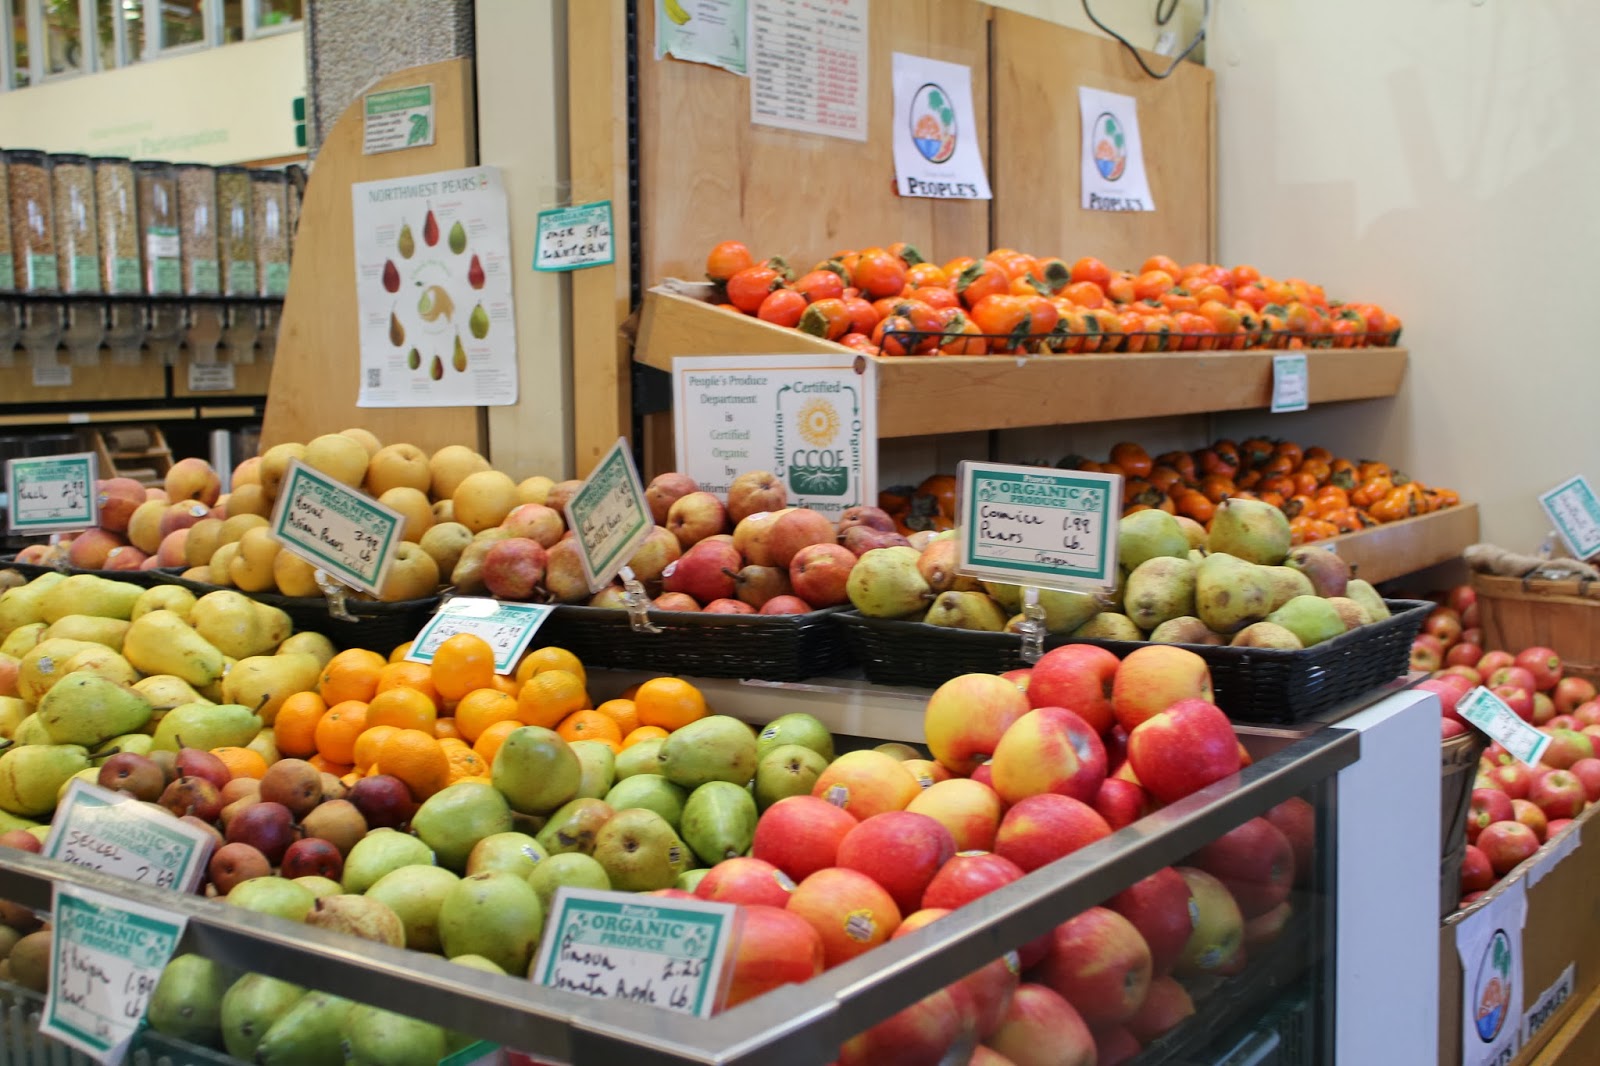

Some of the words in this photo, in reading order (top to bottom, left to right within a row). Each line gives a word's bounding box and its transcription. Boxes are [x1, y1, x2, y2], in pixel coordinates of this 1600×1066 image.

[368, 182, 438, 204] NORTHWEST
[441, 176, 477, 194] PEARS
[543, 242, 607, 260] LANTERN
[688, 375, 727, 388] People's
[728, 374, 769, 387] Produce
[792, 381, 842, 395] Certified
[700, 393, 758, 407] Department
[724, 411, 734, 423] is
[709, 429, 750, 441] Certified
[774, 412, 785, 478] California
[849, 419, 862, 474] Organic
[711, 448, 750, 461] Organic
[791, 449, 845, 471] CCOF
[724, 465, 737, 479] by
[1000, 482, 1080, 500] ORGANIC
[314, 485, 375, 522] ORGANIC
[1010, 494, 1068, 508] PRODUCE
[980, 505, 1045, 525] Comice
[1062, 516, 1091, 535] 1.99
[980, 520, 1024, 544] Pears
[75, 913, 148, 947] ORGANIC
[591, 914, 685, 939] ORGANIC
[81, 932, 132, 958] PRODUCE
[600, 933, 667, 951] PRODUCE
